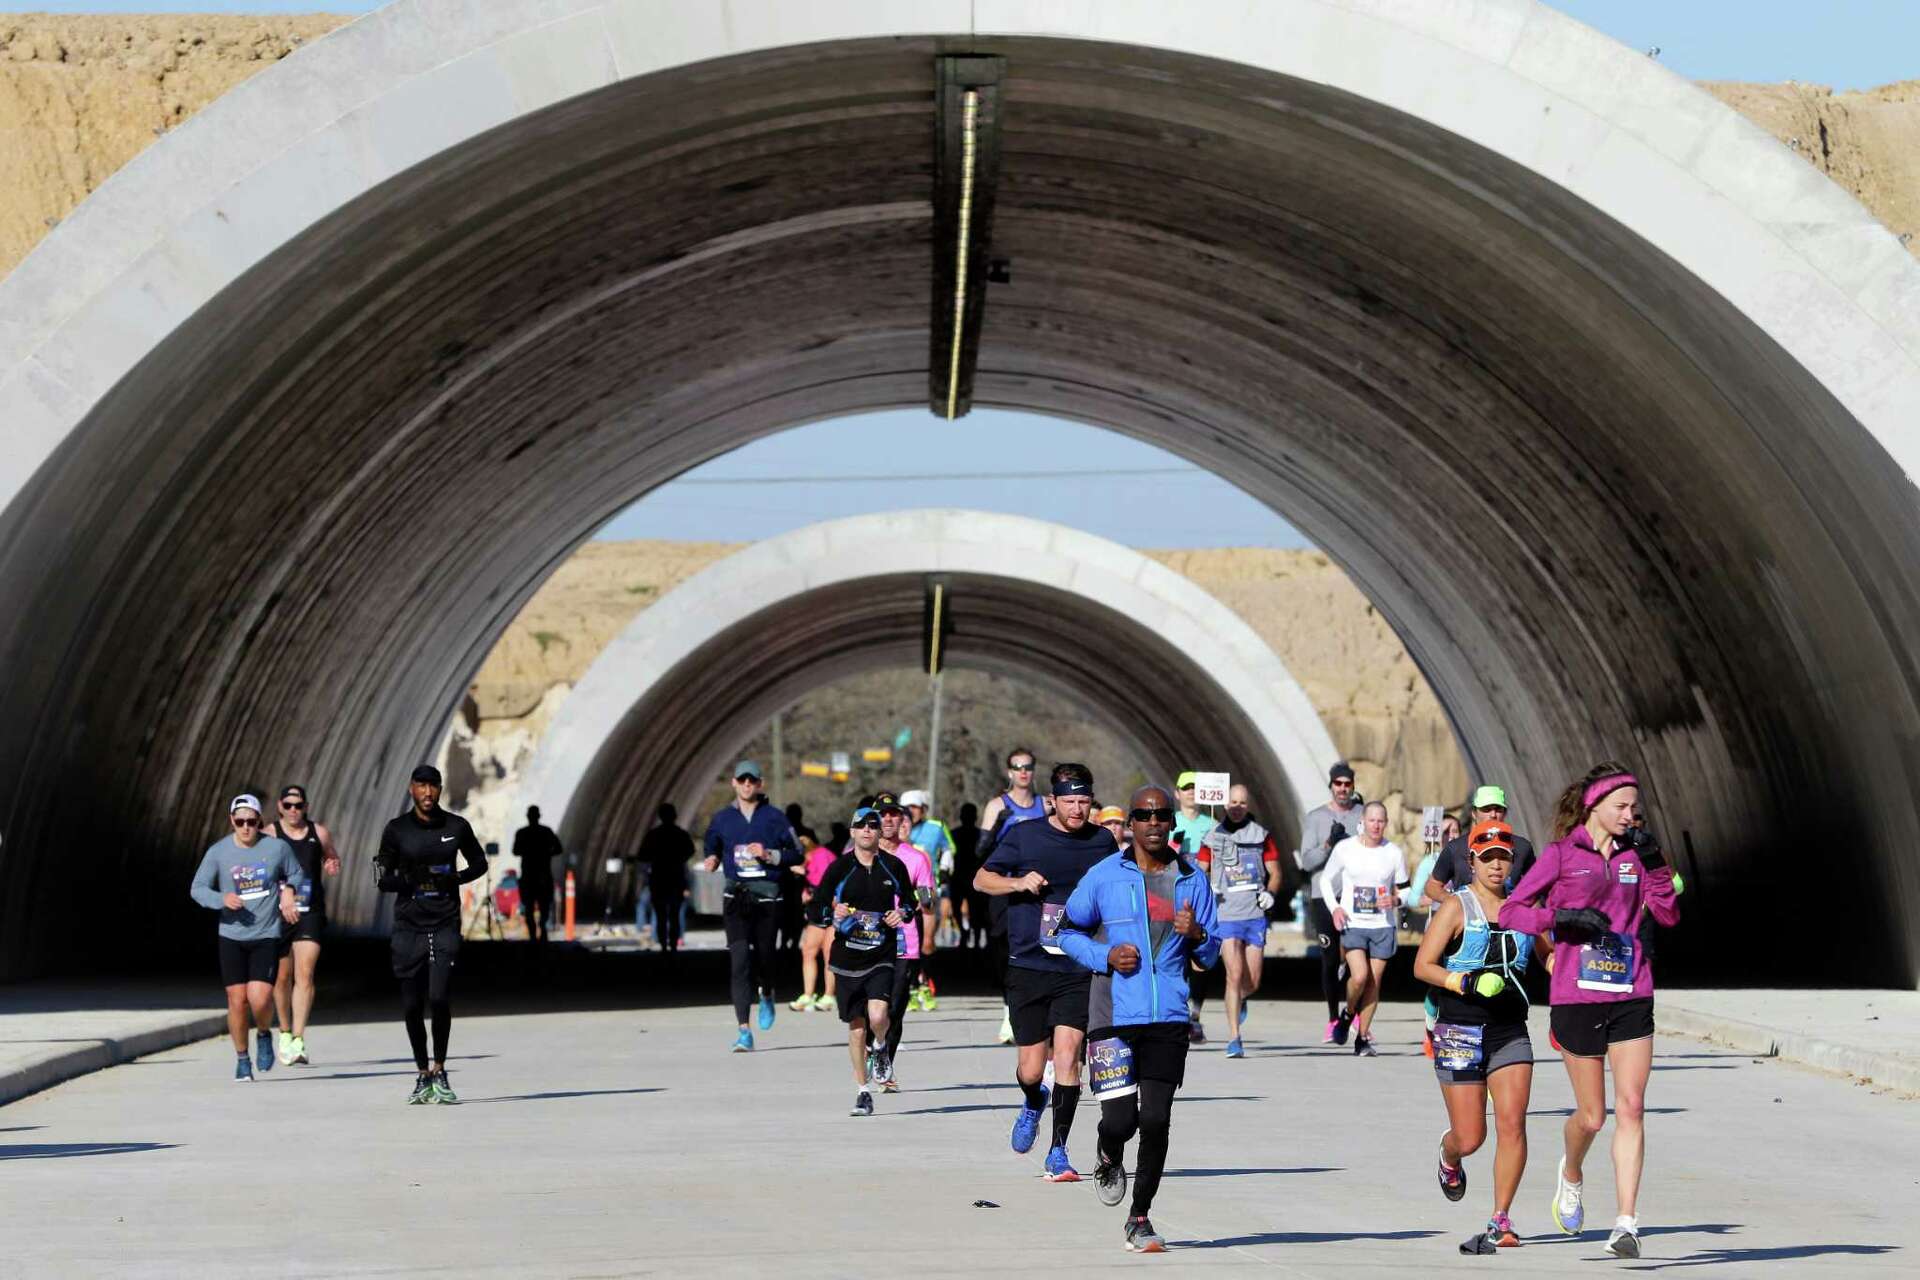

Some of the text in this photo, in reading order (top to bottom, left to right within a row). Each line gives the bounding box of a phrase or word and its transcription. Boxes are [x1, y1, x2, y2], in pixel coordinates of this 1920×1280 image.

[1199, 789, 1223, 801] 3:25
[1587, 960, 1626, 973] A3022
[1094, 1065, 1129, 1082] A3839
[1100, 1079, 1126, 1089] ANDREW
